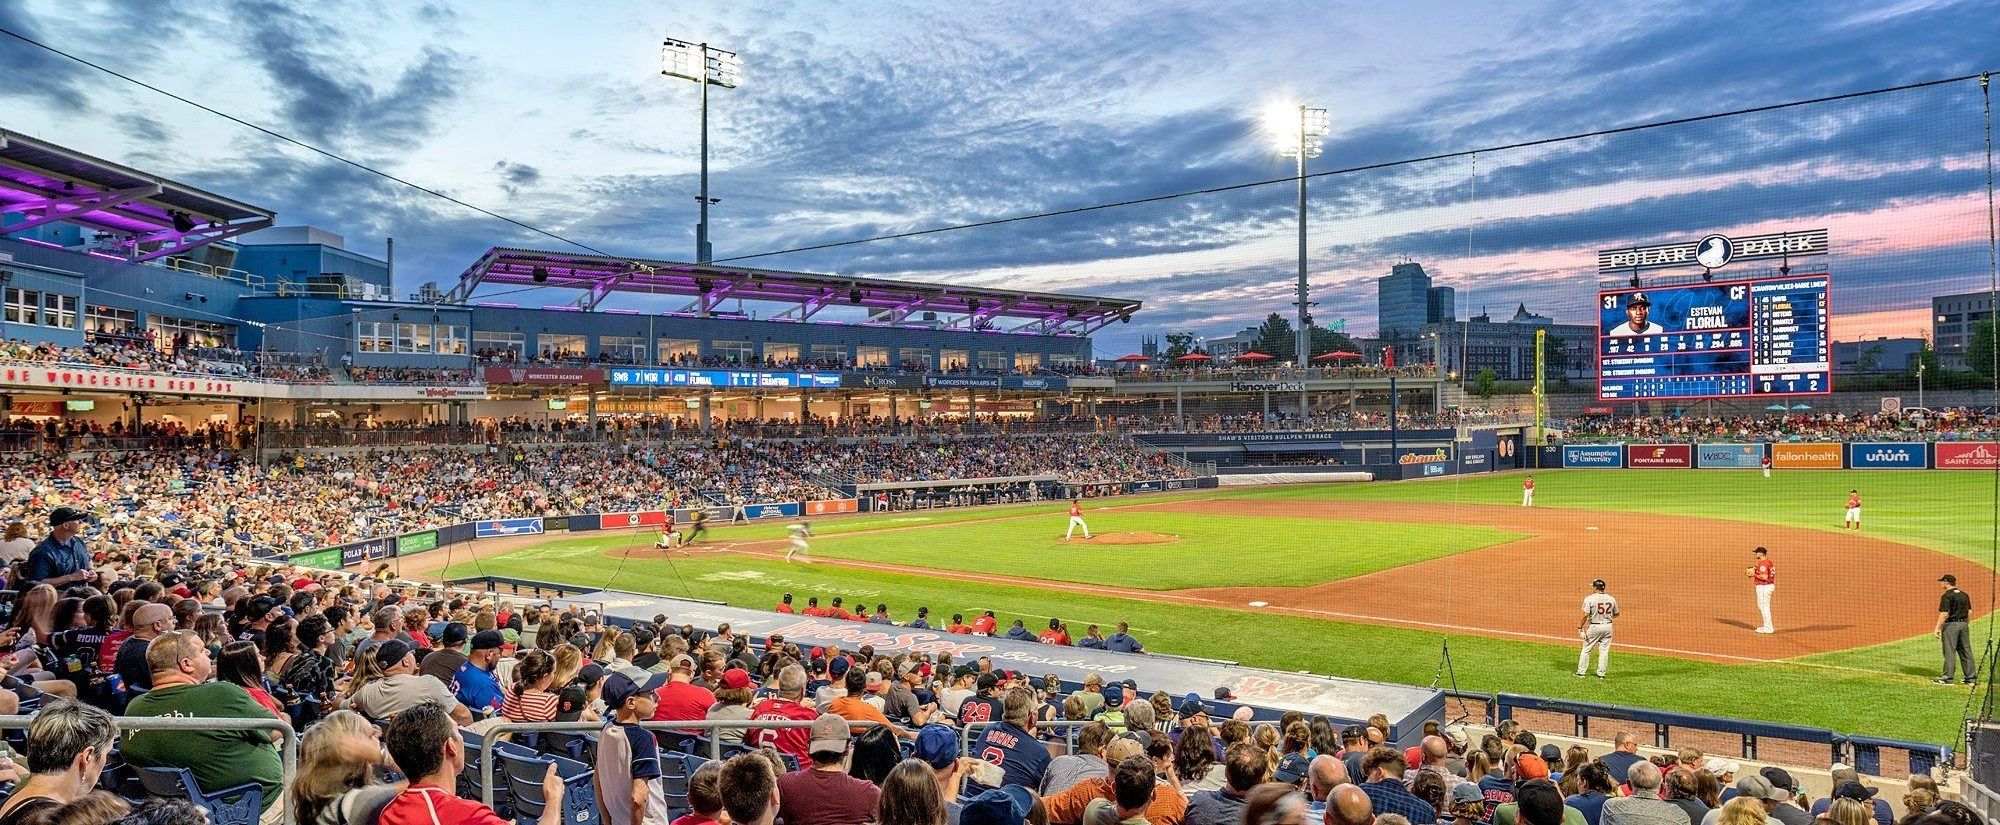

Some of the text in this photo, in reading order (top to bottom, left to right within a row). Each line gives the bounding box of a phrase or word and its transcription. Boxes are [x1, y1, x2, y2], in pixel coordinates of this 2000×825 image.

[1609, 235, 1814, 268] POLAR PARK
[1730, 286, 1746, 300] CF
[1604, 296, 1617, 309] 31
[1690, 306, 1723, 317] ESTEVAN
[1686, 315, 1728, 329] FLORIAL
[1626, 345, 1635, 353] 42
[0, 369, 232, 392] HE WORCESTER RED SOX
[510, 369, 526, 381] W
[613, 372, 628, 382] SWB
[635, 373, 640, 382] 7
[644, 373, 658, 382] WOR
[664, 373, 669, 383] 0
[674, 374, 685, 382] 4TH
[752, 378, 757, 386] 2
[1231, 382, 1304, 391] Hanover Deck
[1763, 380, 1818, 392] 0 1 2
[595, 403, 664, 411] ACHO NACHO MAN
[1580, 450, 1617, 458] Assumption
[1776, 452, 1839, 461] fallonhealth
[344, 548, 362, 559] POLAR
[1597, 603, 1611, 614] 52
[991, 650, 1137, 674] Baseball
[963, 701, 991, 723] 29
